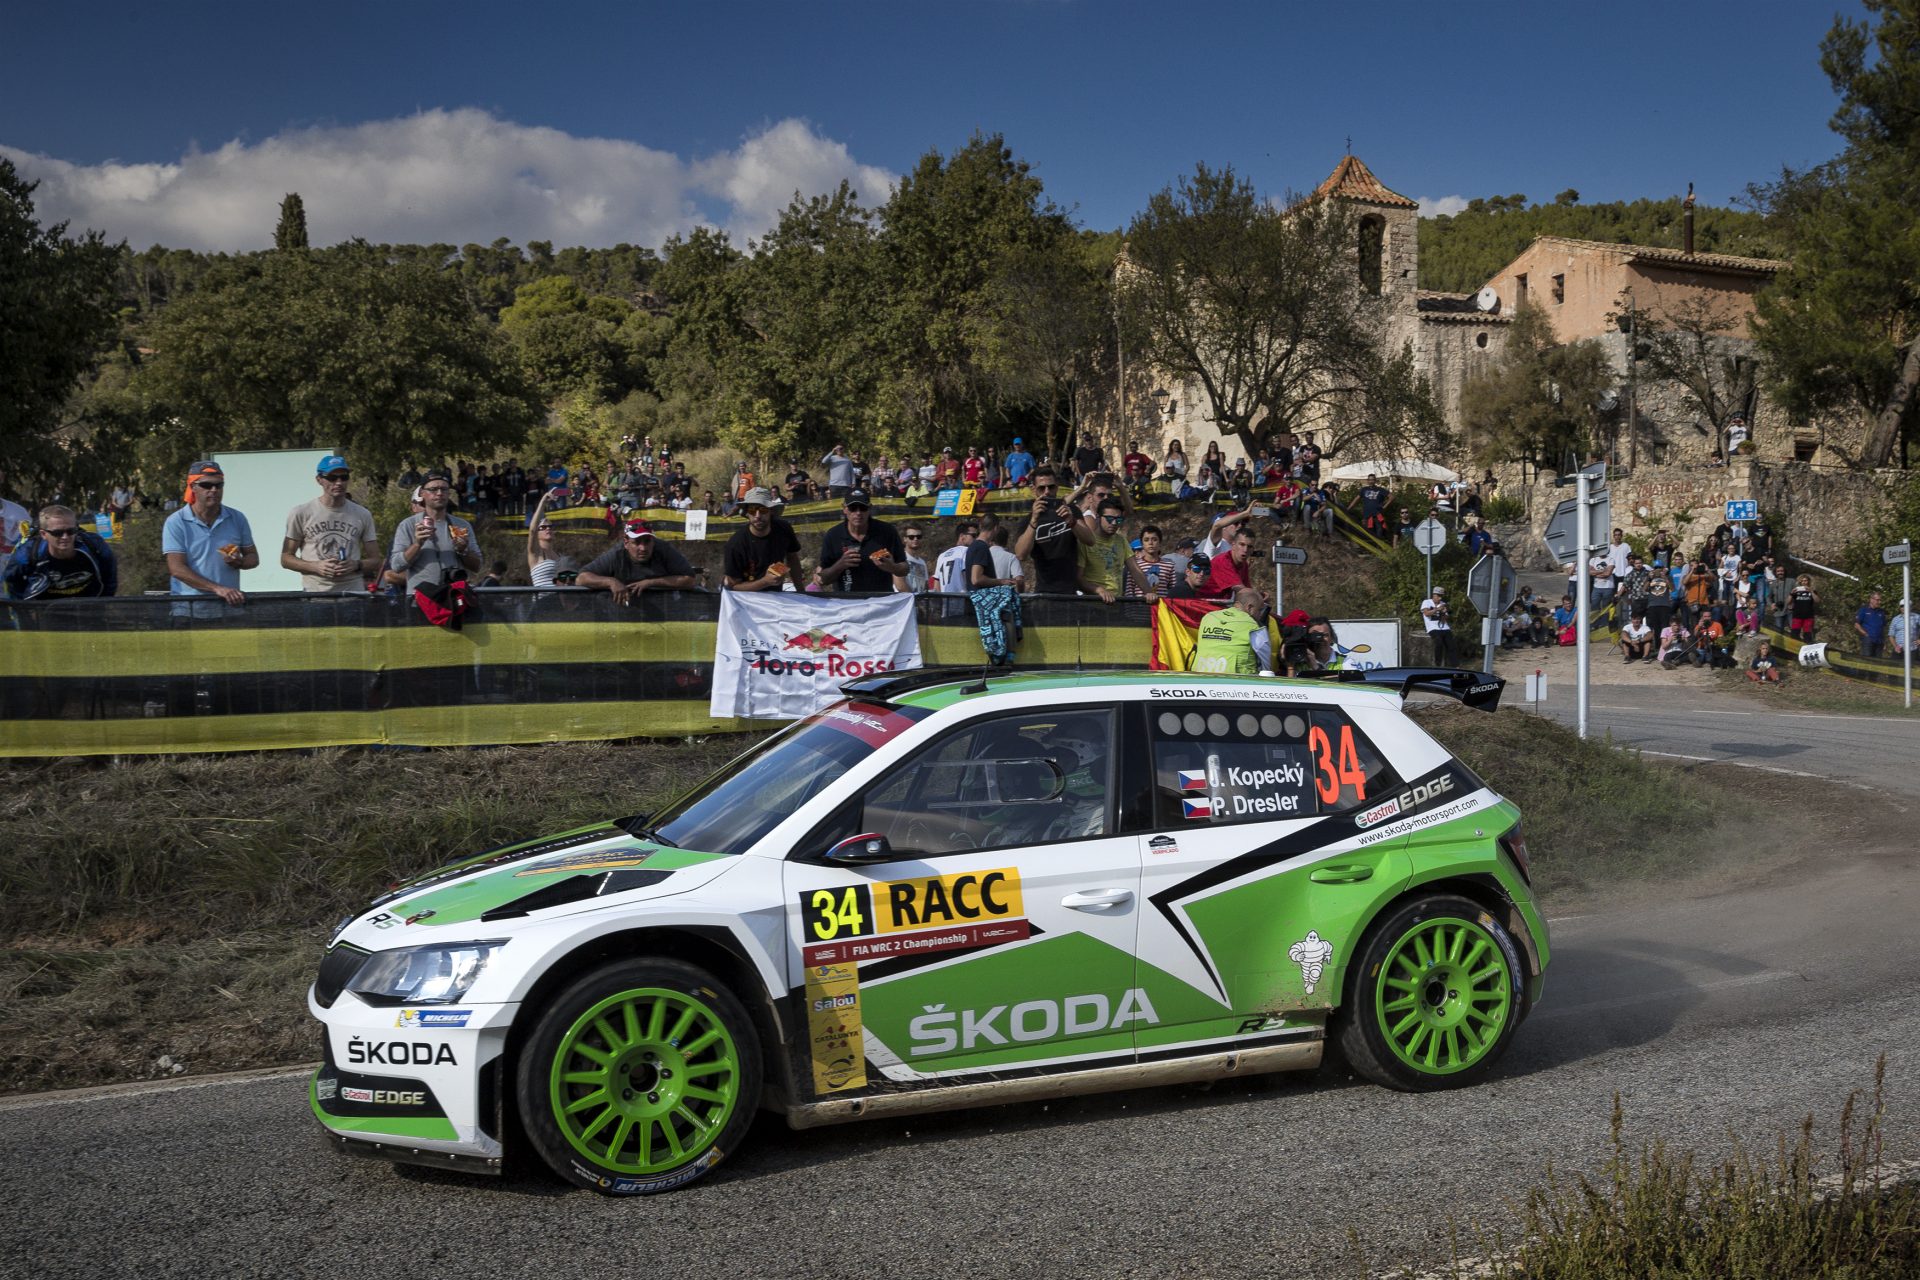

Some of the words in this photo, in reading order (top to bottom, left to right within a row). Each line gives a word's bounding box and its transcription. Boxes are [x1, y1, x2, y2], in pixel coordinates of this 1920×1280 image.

[940, 560, 955, 586] 17
[754, 650, 816, 677] Toro
[1150, 688, 1207, 698] ŠKODA
[1209, 689, 1250, 699] Genuine
[1252, 690, 1309, 701] Accessories
[1470, 682, 1499, 694] ŠKODA
[1228, 762, 1304, 790] Kopecký
[1308, 725, 1367, 805] 34
[1212, 796, 1231, 816] P.
[1232, 792, 1299, 815] Dresler
[1366, 801, 1398, 824] Castrol
[1398, 772, 1455, 812] EDGE
[1358, 798, 1479, 845] www.skoda-motorsport.com
[811, 887, 864, 940] 34
[889, 872, 1009, 927] RACC
[366, 912, 402, 931] R5
[852, 946, 869, 956] FIA
[870, 943, 893, 954] WRC
[894, 941, 901, 950] 2
[902, 934, 968, 950] Championship
[814, 996, 855, 1012] Salou
[423, 1014, 471, 1022] MICHELIN
[909, 987, 1160, 1056] ŠKODA
[1236, 1017, 1286, 1034] R5
[348, 1035, 458, 1066] ŠKODA
[374, 1090, 426, 1105] EDGE
[617, 1168, 697, 1191] MICHELIN
